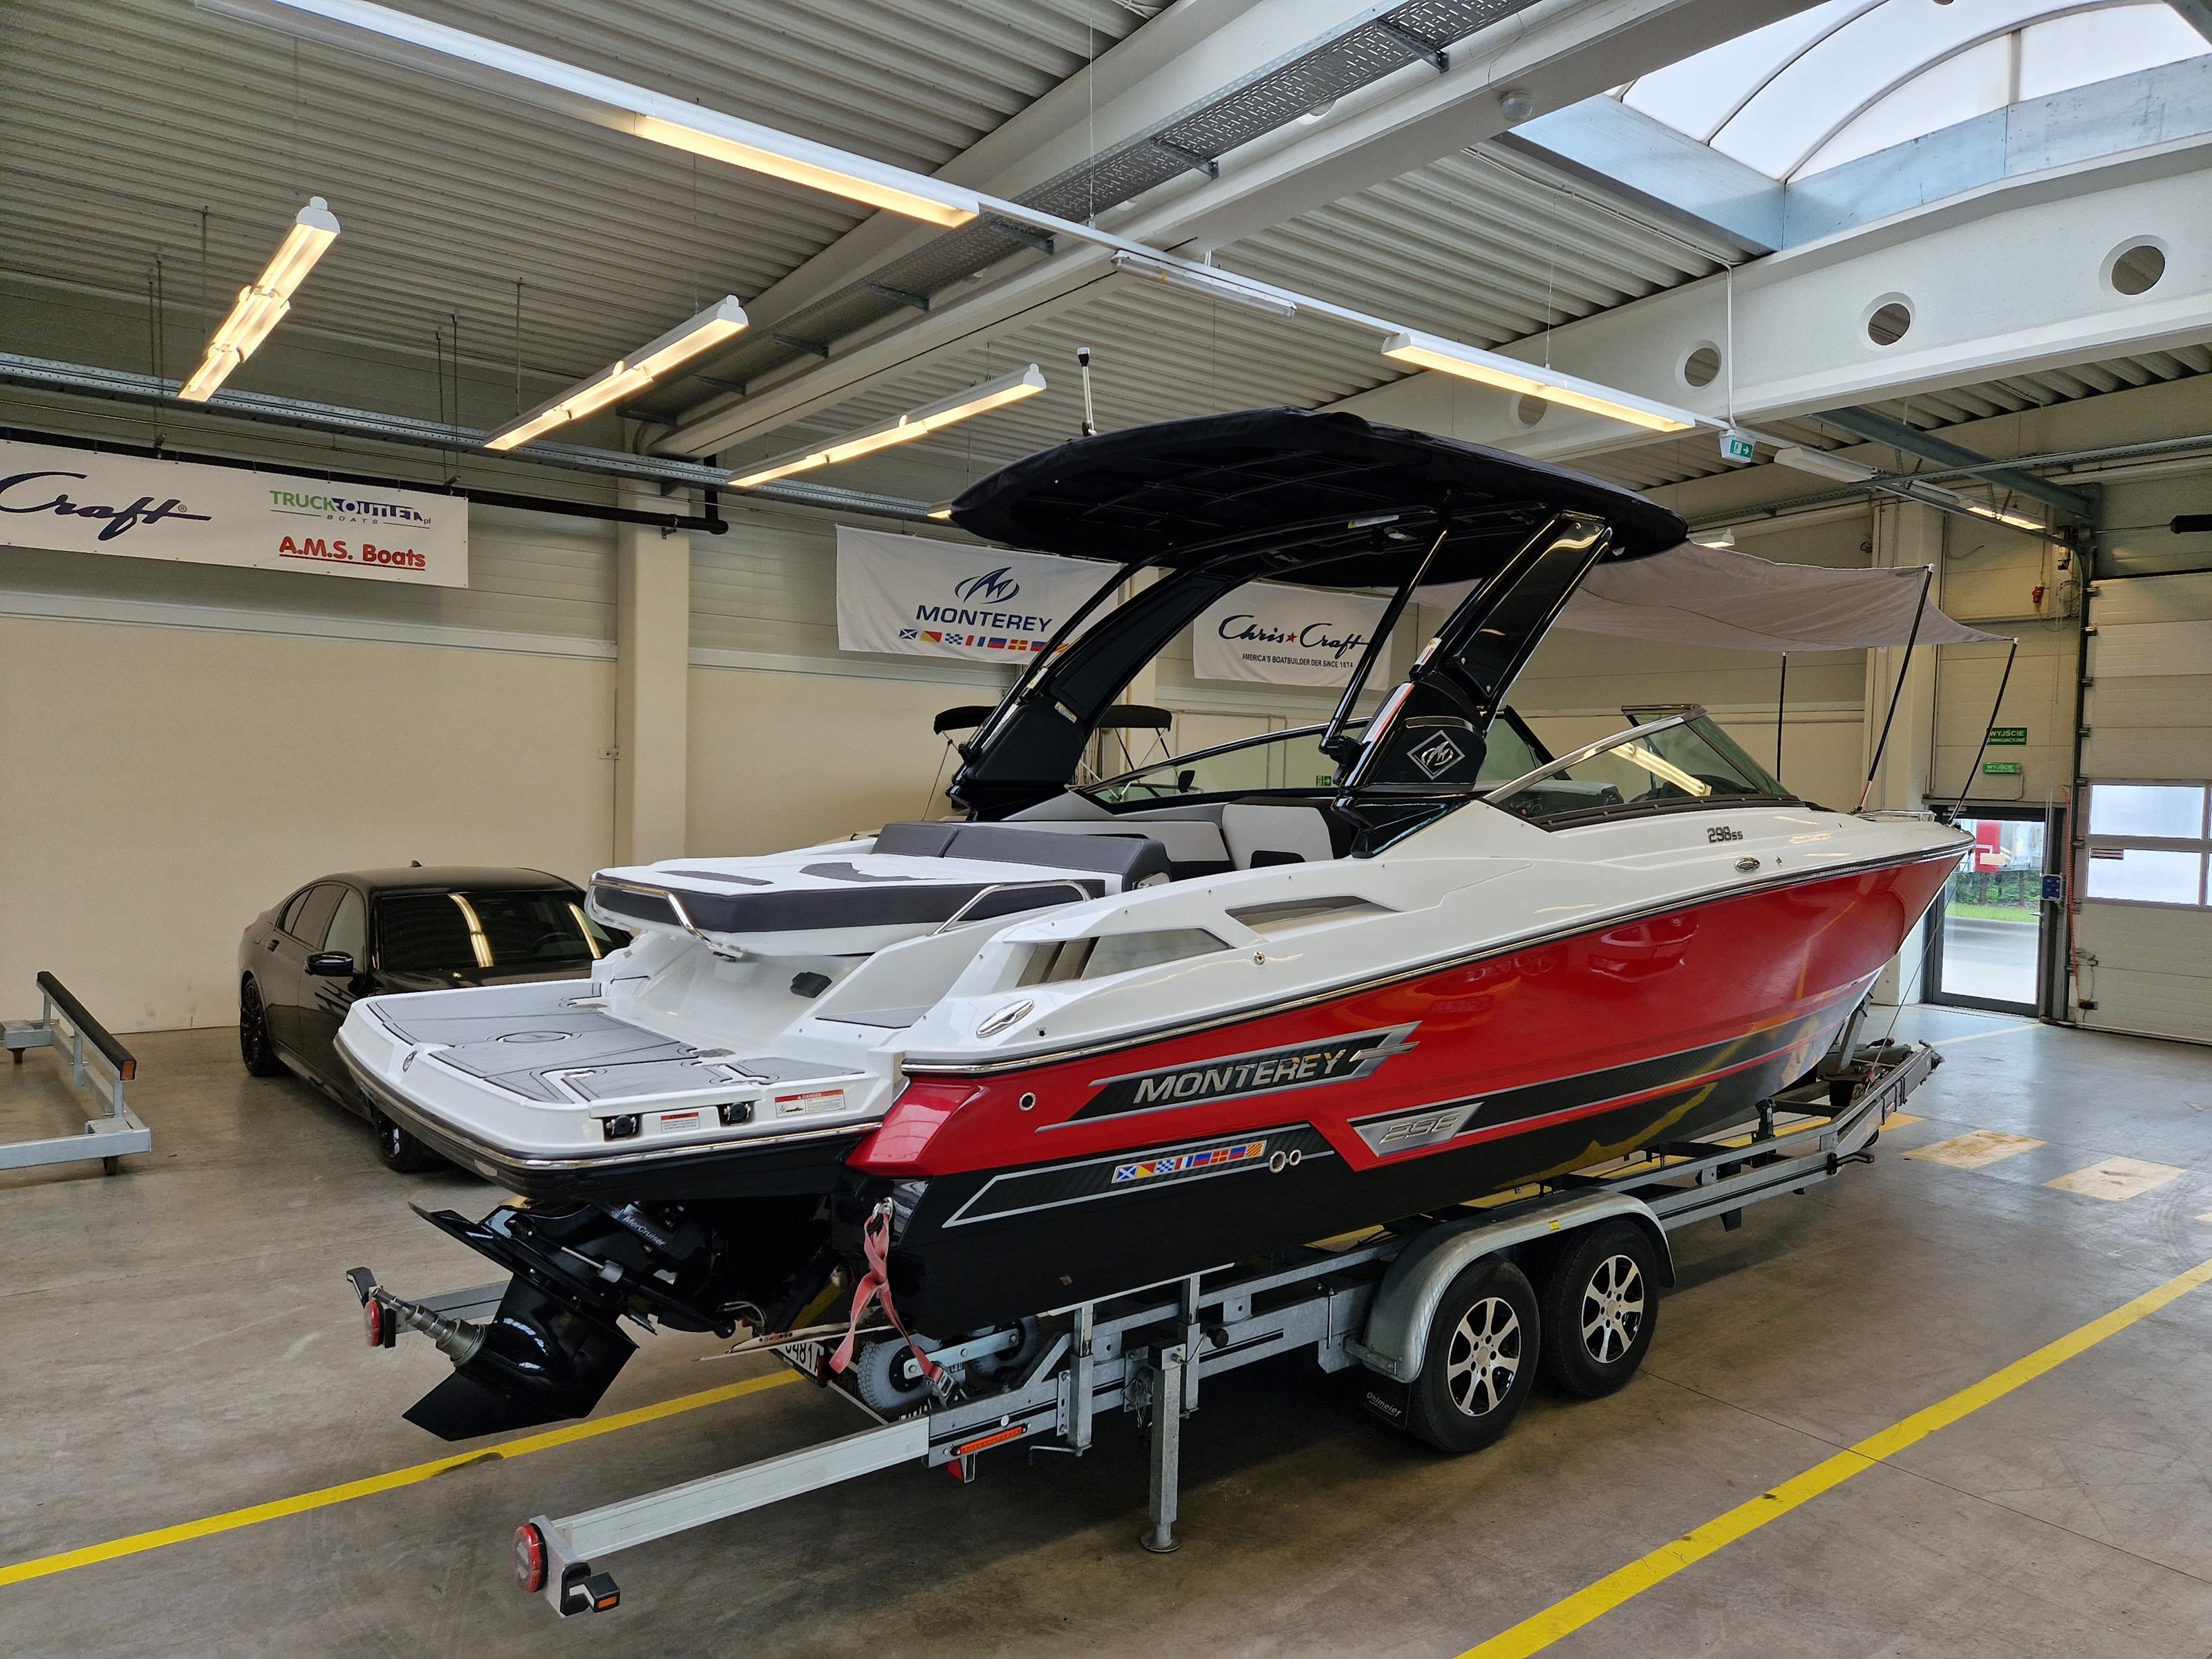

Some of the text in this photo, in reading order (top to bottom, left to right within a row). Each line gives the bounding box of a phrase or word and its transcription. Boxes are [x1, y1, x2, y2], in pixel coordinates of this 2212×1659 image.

[326, 514, 379, 525] BOATS
[279, 536, 427, 568] A.M.S. Boats
[916, 605, 1053, 632] MONTEREY
[1218, 615, 1369, 659] Chris Craft
[1242, 653, 1271, 663] AMERICA'S
[1272, 656, 1311, 666] BOATBUILDER
[1133, 1049, 1347, 1104] MONTEREY
[1378, 1112, 1461, 1145] 298
[622, 1215, 666, 1246] MerCruiser
[1367, 1391, 1402, 1417] Ohlmeier
